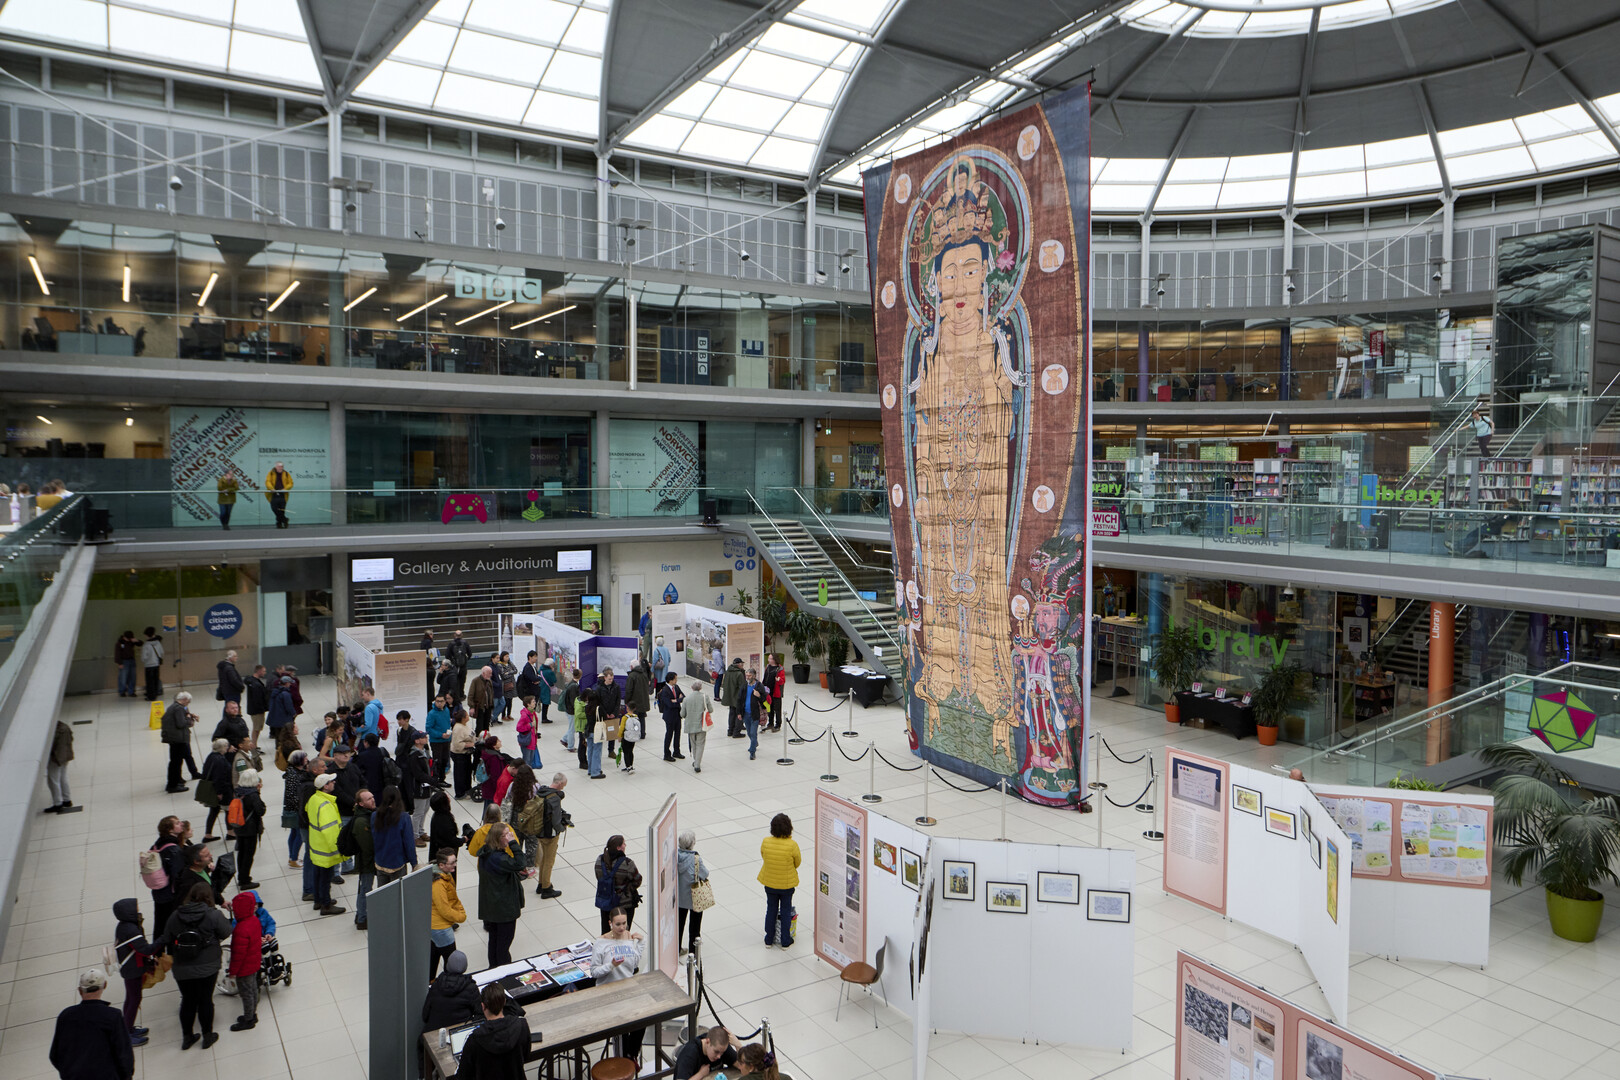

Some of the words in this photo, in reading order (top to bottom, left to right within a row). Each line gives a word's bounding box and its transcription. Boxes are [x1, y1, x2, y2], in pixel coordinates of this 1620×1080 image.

[458, 273, 540, 302] BBC
[698, 337, 708, 375] BBC
[192, 407, 236, 445] YARMOUT
[175, 449, 216, 486] KING'S
[214, 421, 248, 452] LYNN
[652, 436, 682, 467] FAKENHAM
[659, 426, 697, 467] NORWICH
[858, 445, 874, 454] STOP
[217, 453, 260, 490] DEREHAM
[645, 461, 674, 493] THETFORD
[1362, 484, 1443, 506] Library
[1092, 514, 1118, 524] WICH
[1228, 526, 1264, 536] CREATE
[1234, 516, 1257, 526] PLAY
[730, 538, 747, 548] Toilets
[1212, 535, 1279, 547] COLLABORATE
[398, 560, 454, 575] Gallery
[459, 560, 470, 572] &
[475, 556, 554, 572] Auditorium
[661, 564, 681, 572] forum
[1432, 608, 1442, 638] Library
